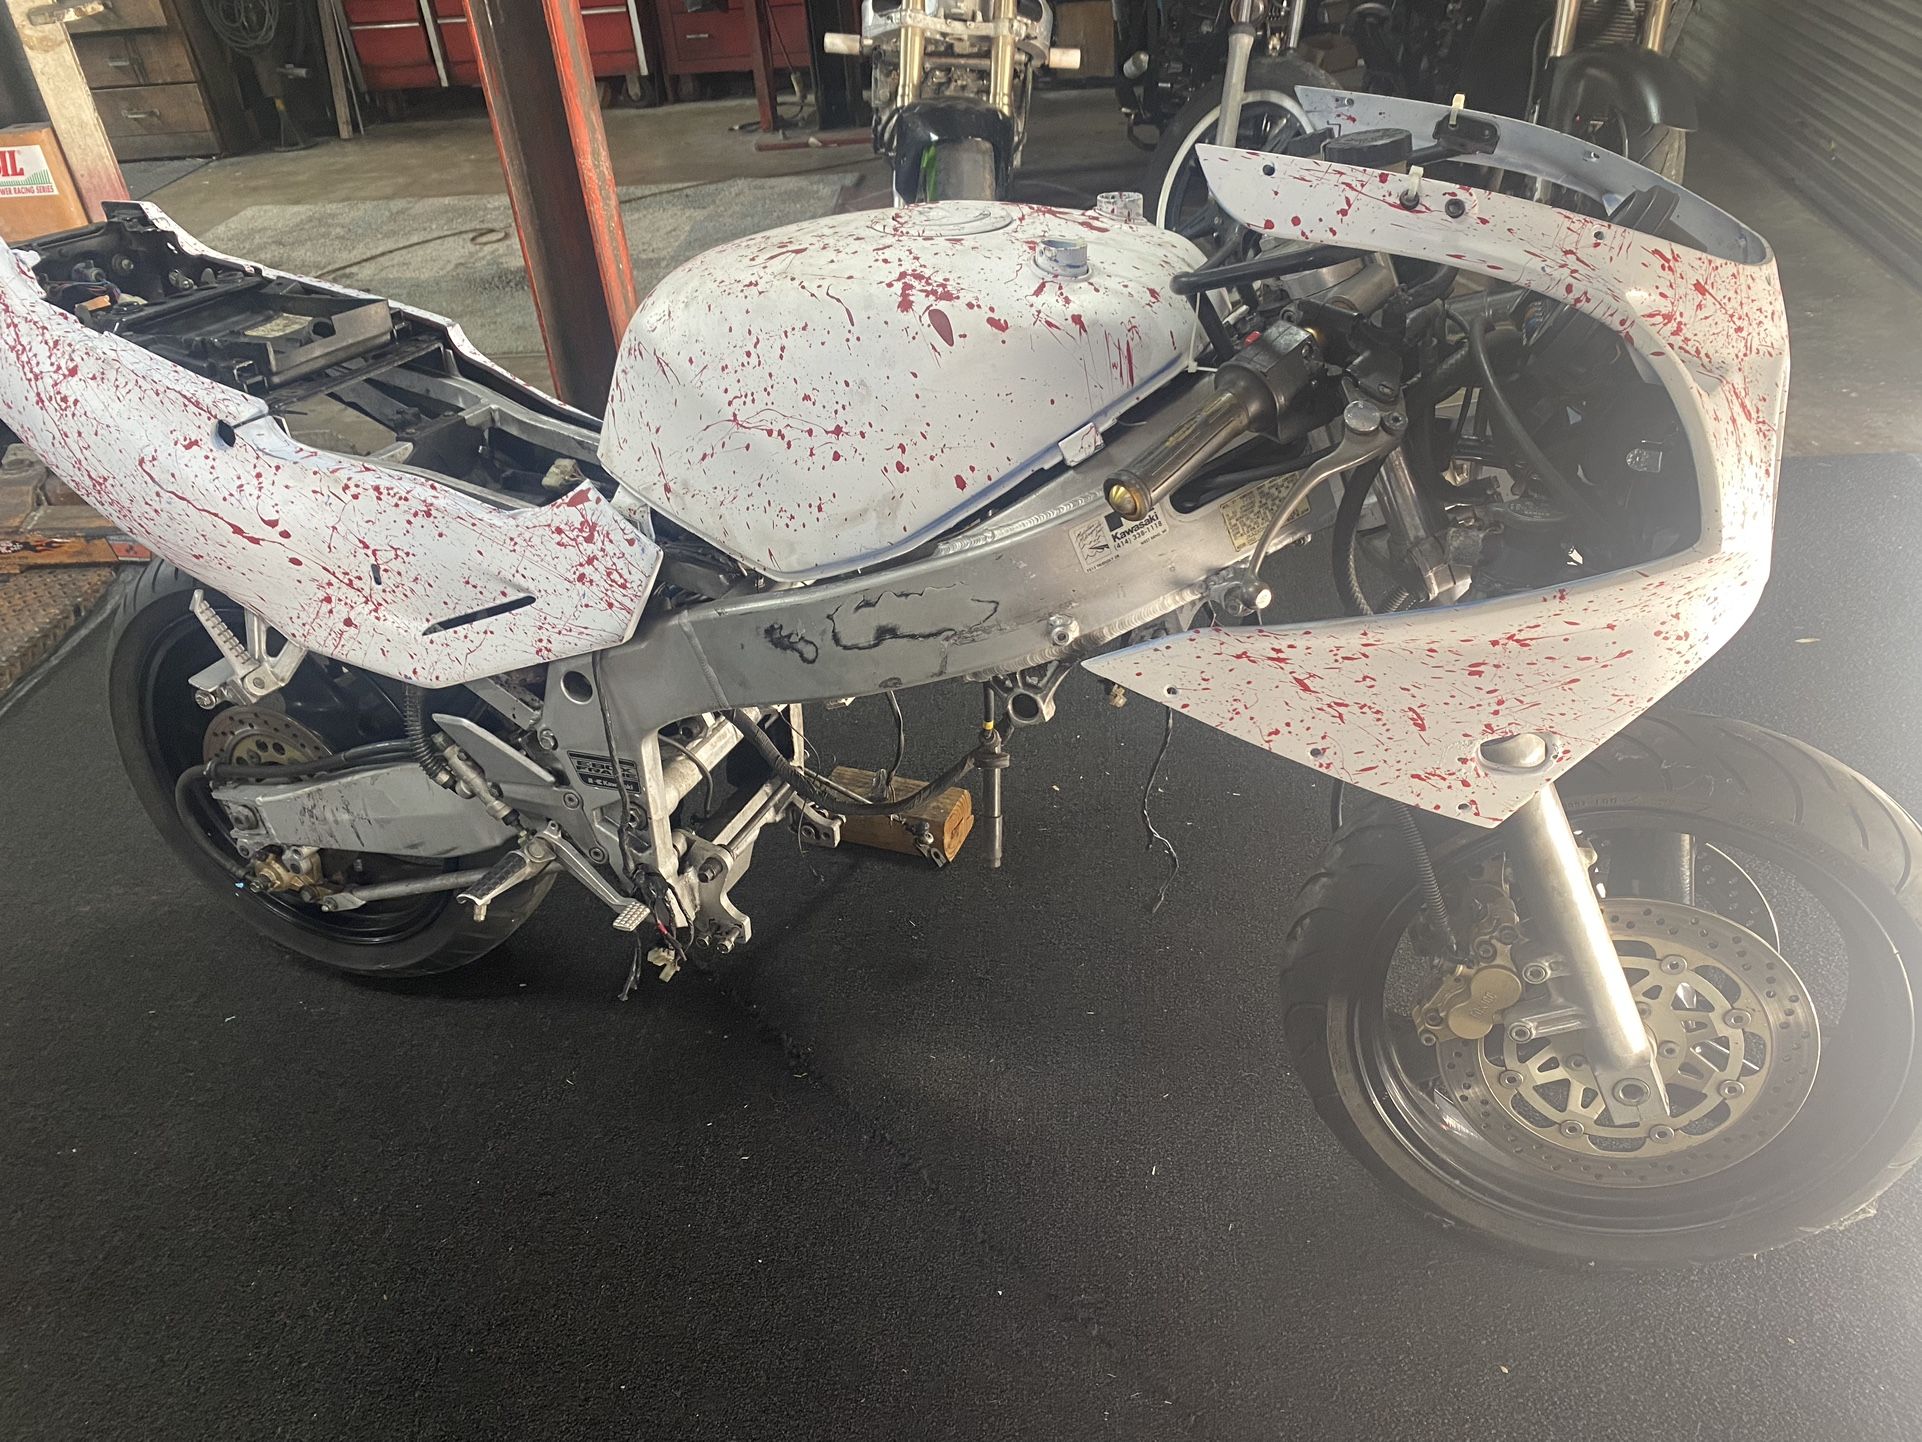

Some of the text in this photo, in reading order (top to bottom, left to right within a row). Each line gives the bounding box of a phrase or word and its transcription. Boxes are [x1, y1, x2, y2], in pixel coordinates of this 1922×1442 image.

[0, 150, 24, 176] IL
[13, 186, 35, 195] RACING
[36, 185, 54, 194] SERIES
[1111, 511, 1159, 542] Kawasaki
[1114, 538, 1131, 551] (414)
[576, 765, 637, 778] FRAE
[602, 780, 633, 791] Kawaki
